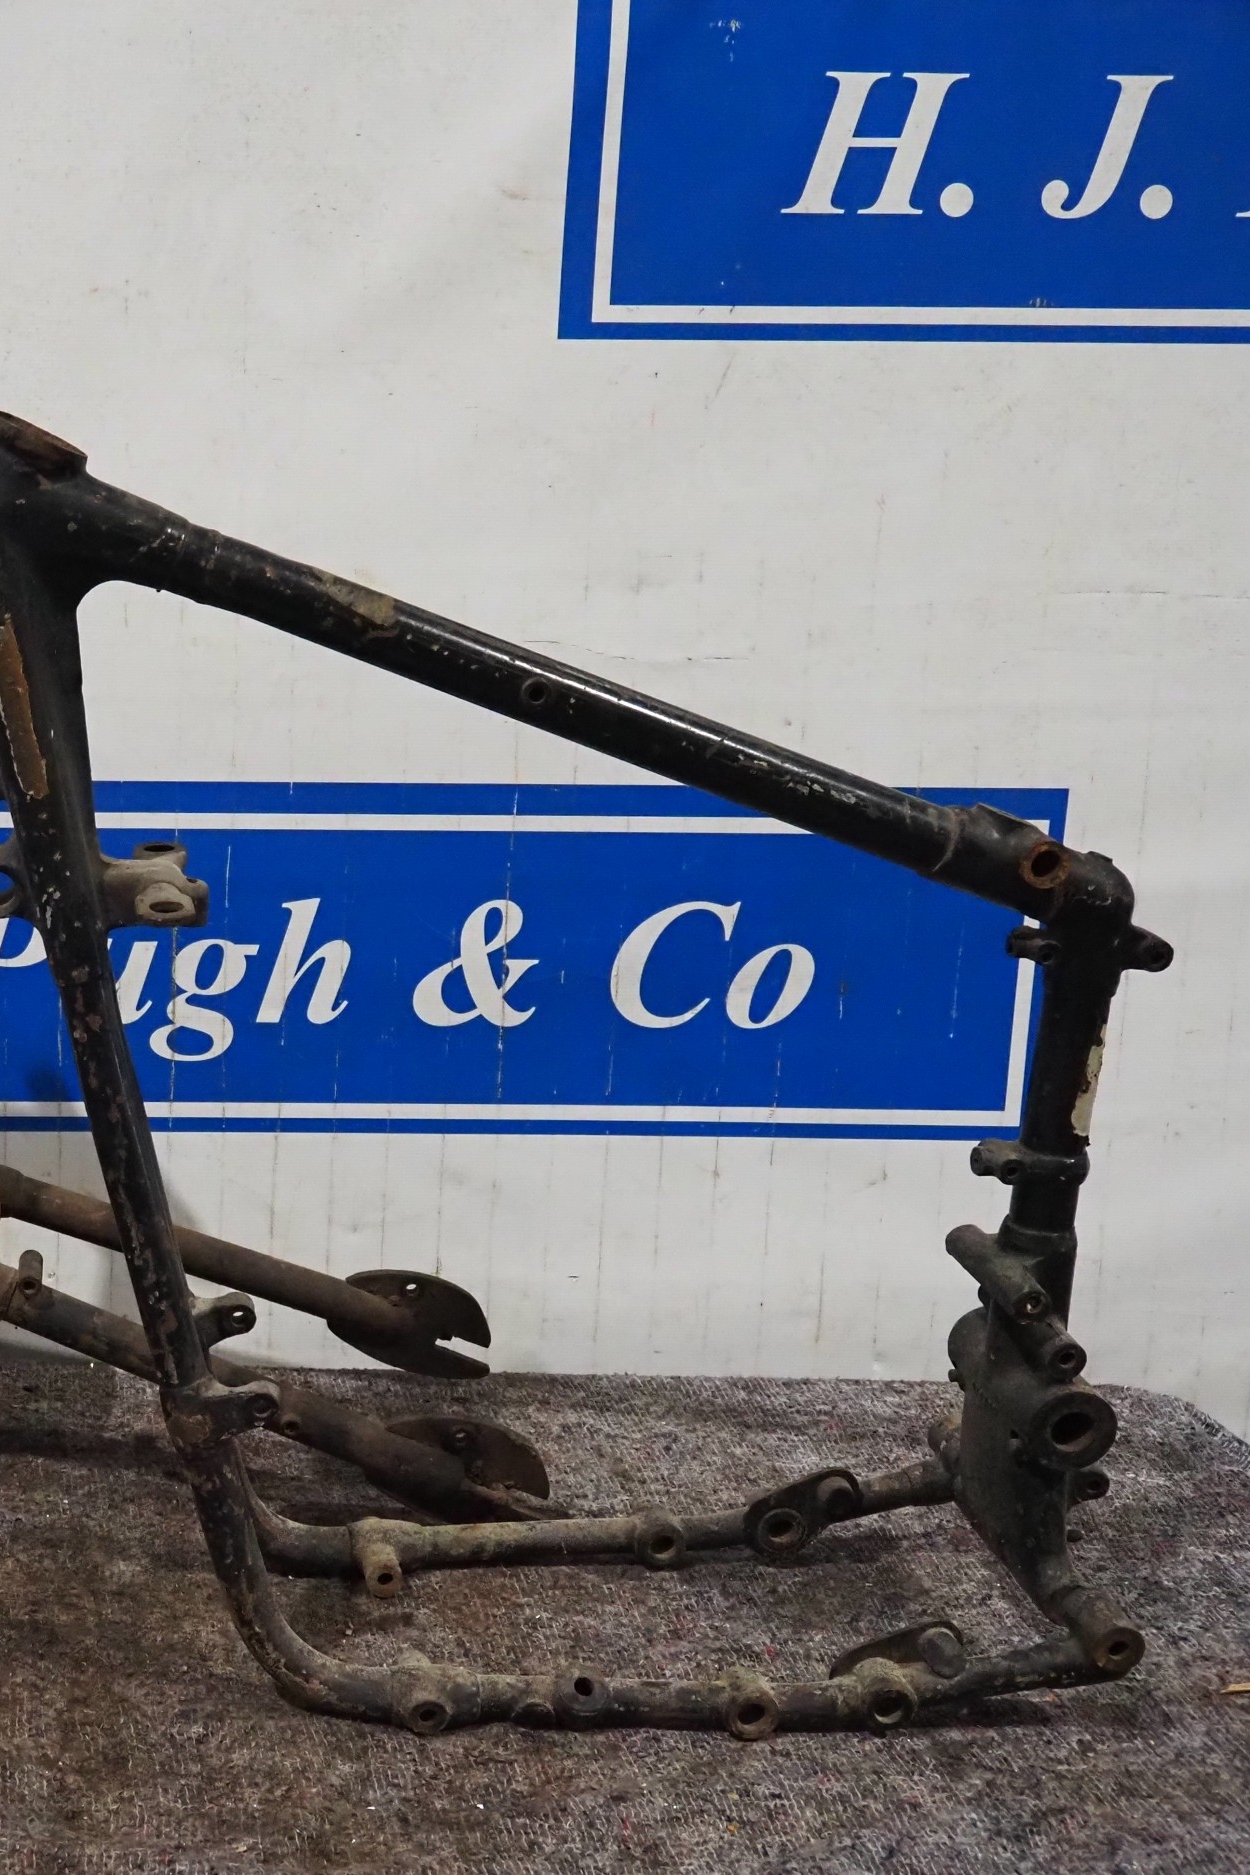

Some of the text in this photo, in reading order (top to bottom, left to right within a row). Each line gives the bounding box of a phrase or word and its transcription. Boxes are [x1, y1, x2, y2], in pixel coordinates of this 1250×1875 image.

[780, 71, 1174, 220] H. J.
[412, 899, 539, 1028] &
[609, 900, 816, 1030] Co
